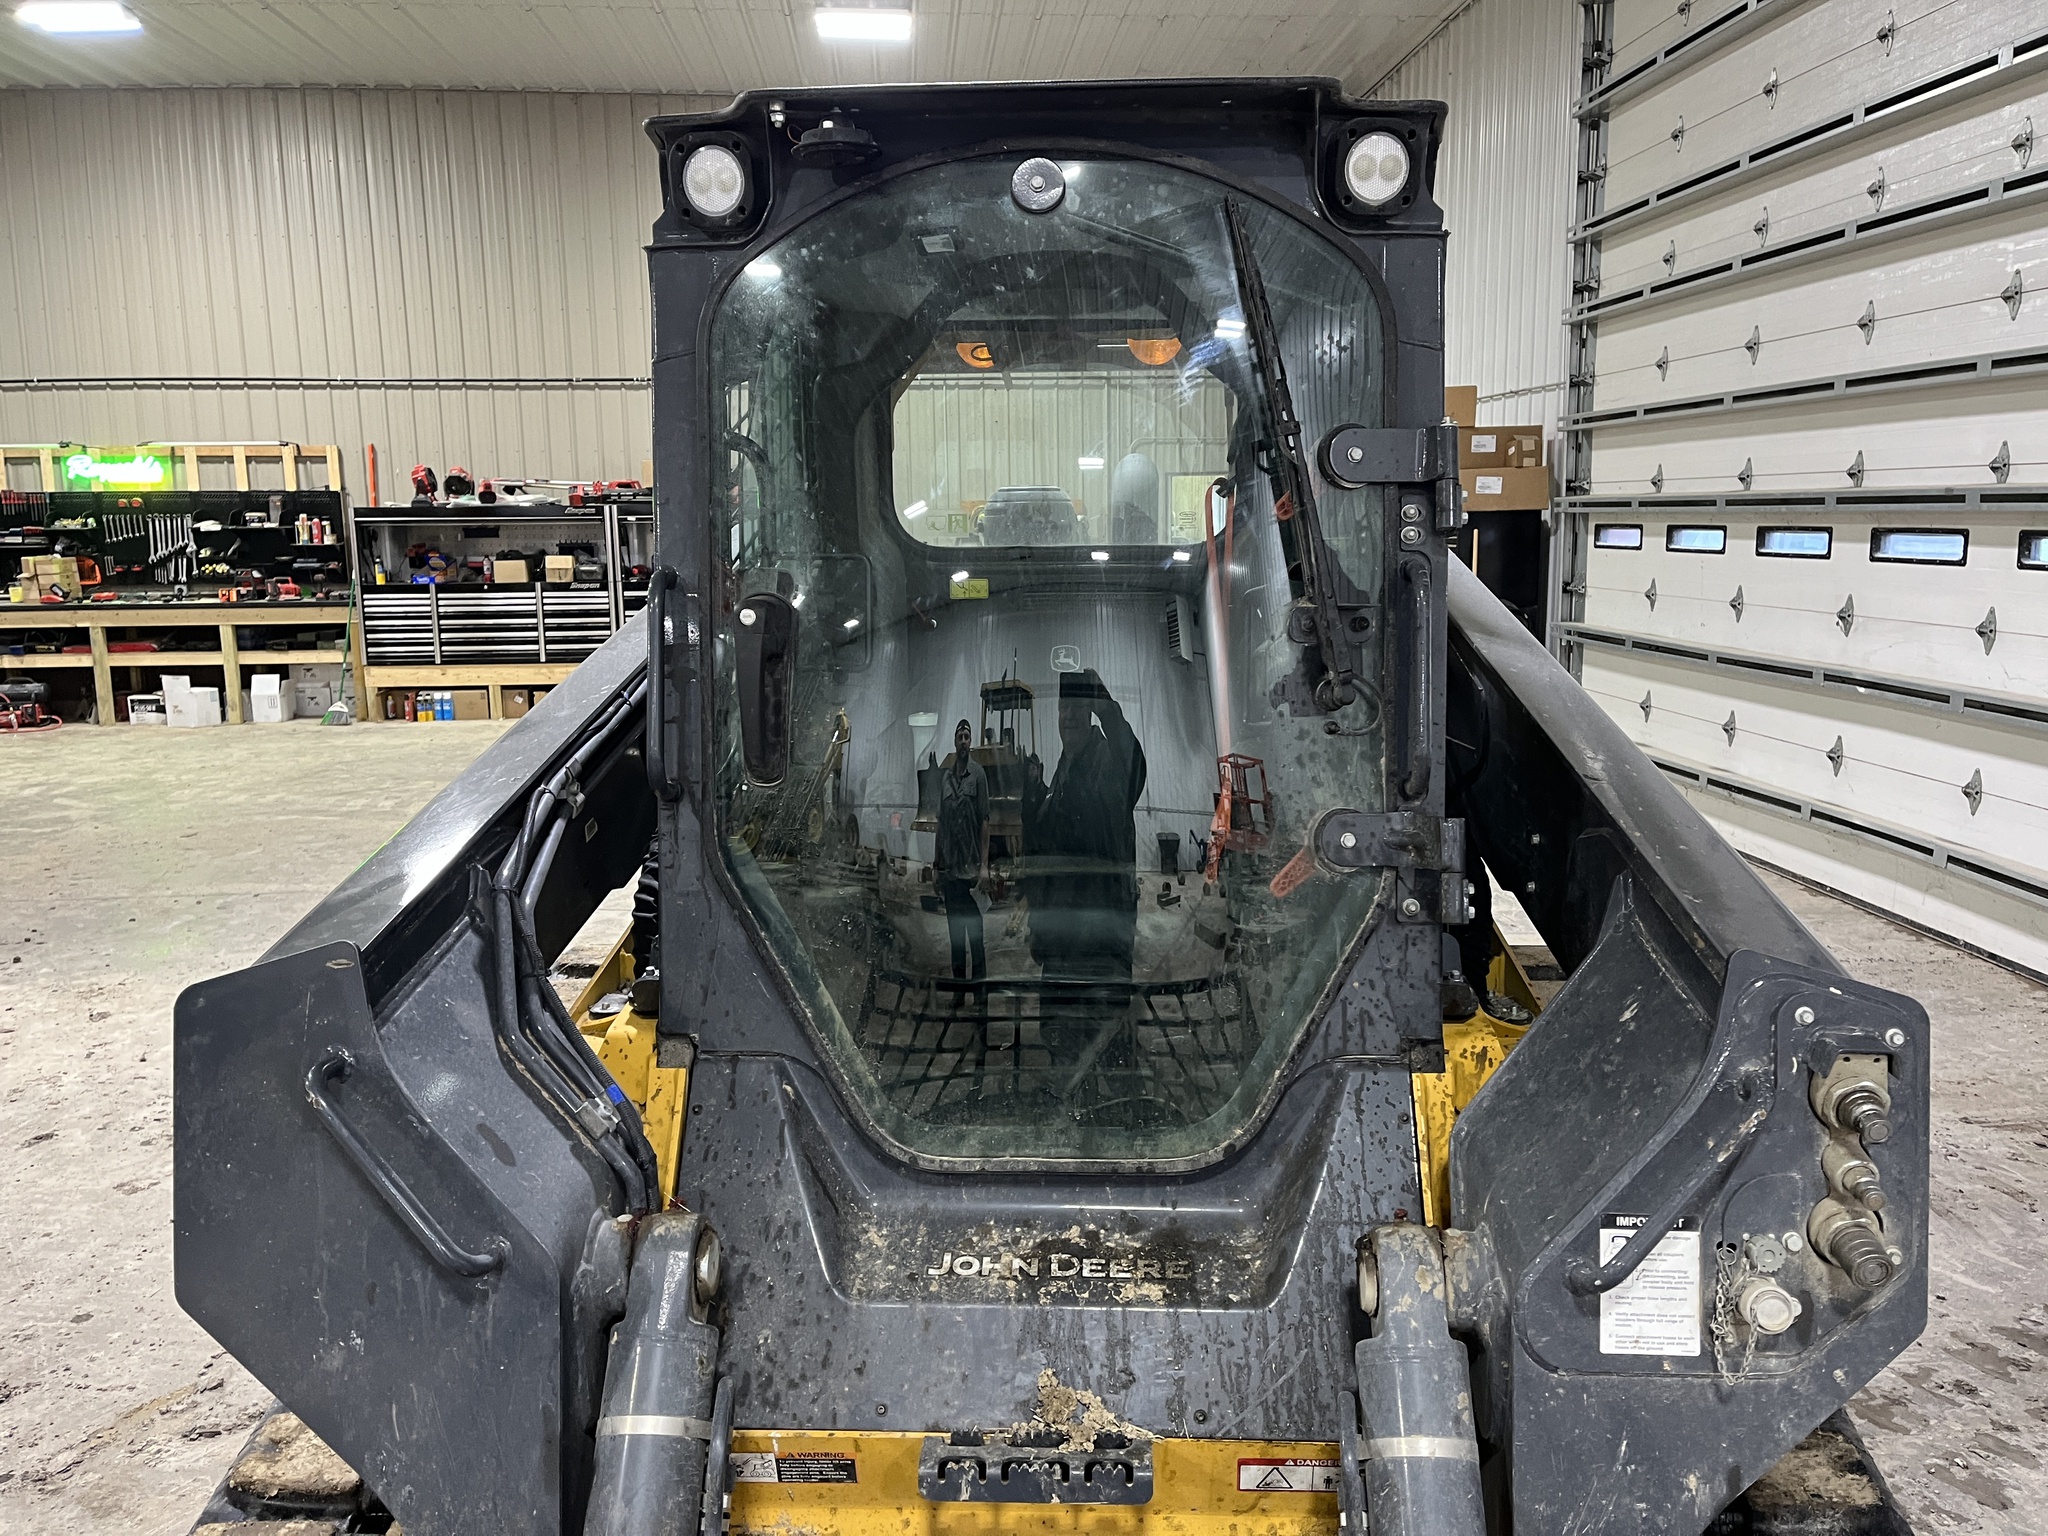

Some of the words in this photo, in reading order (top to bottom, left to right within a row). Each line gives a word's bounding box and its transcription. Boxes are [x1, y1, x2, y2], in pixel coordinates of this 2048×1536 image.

[570, 582, 600, 590] Snap-on
[1616, 1216, 1684, 1228] IMPOT
[927, 1251, 1039, 1277] JOHN
[1050, 1253, 1191, 1279] DEERE
